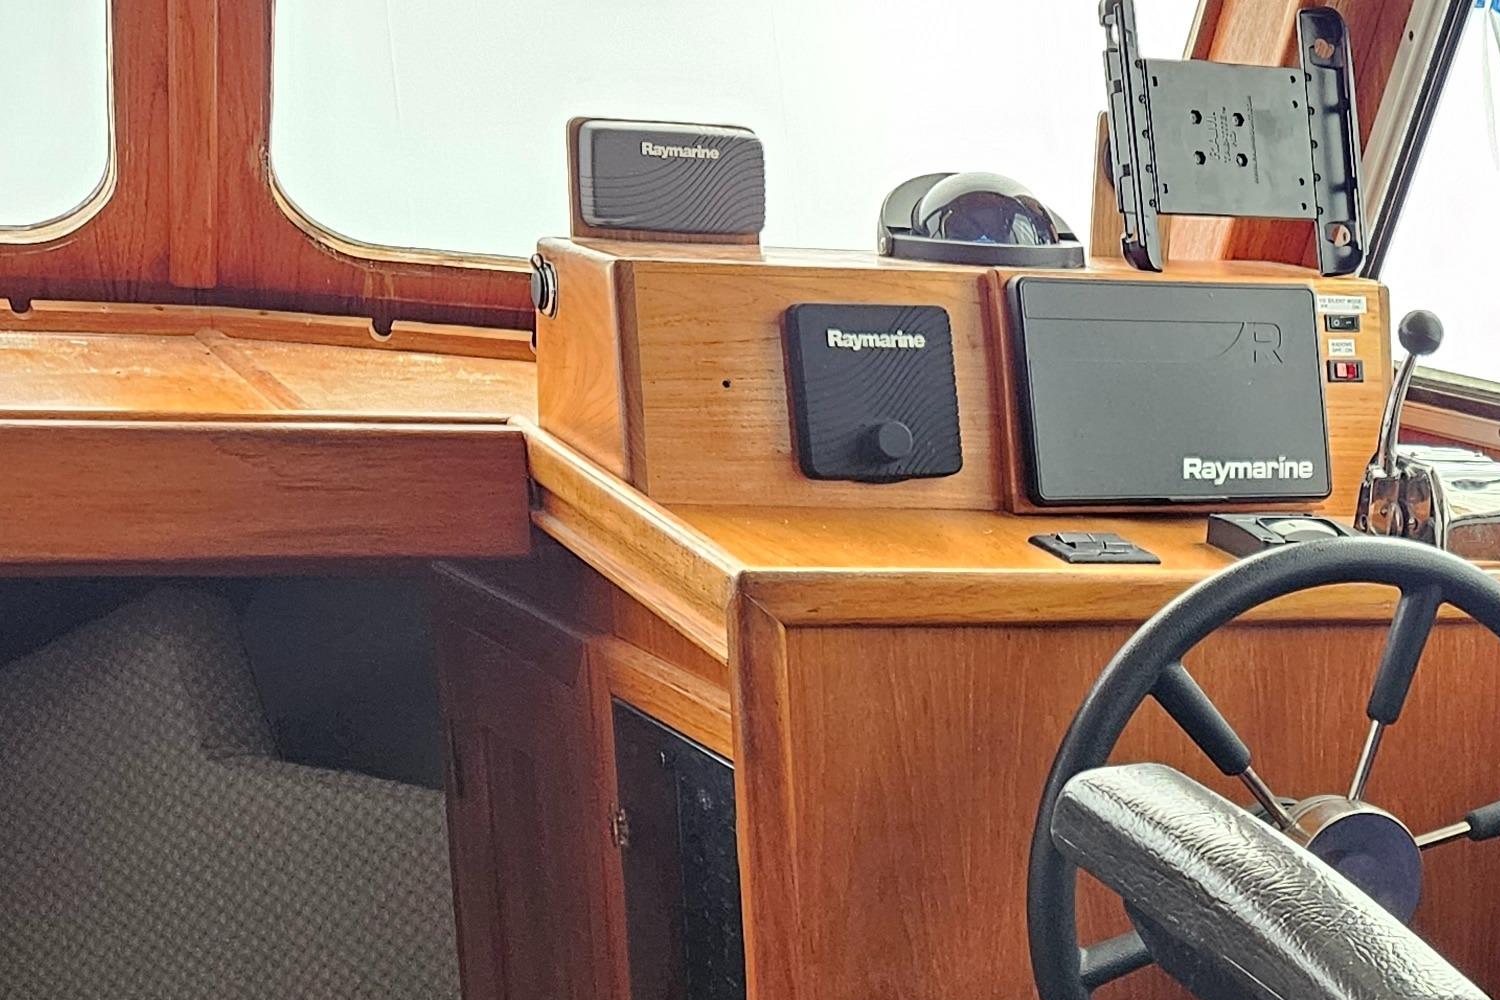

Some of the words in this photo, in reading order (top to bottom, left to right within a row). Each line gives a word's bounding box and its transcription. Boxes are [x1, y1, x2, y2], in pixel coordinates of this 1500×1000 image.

[641, 141, 720, 159] Raymarine
[827, 329, 926, 351] Raymarine
[1183, 456, 1313, 485] Raymarine
